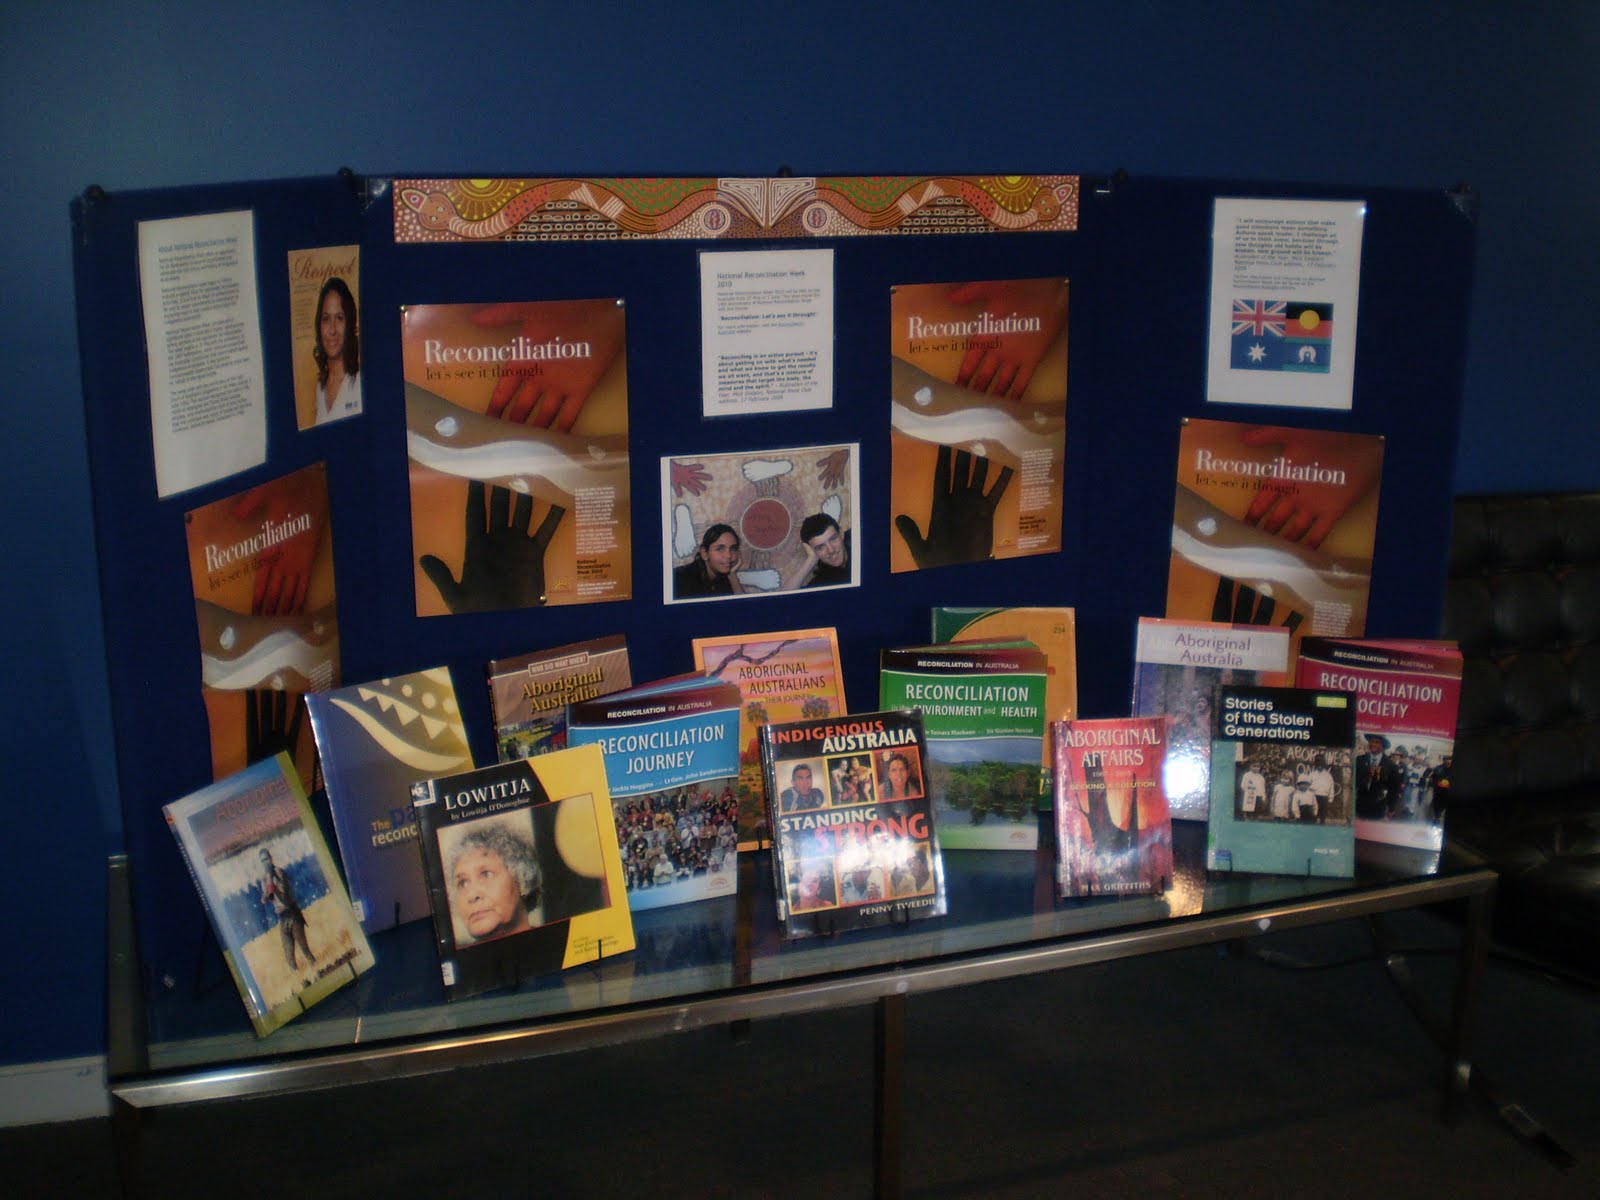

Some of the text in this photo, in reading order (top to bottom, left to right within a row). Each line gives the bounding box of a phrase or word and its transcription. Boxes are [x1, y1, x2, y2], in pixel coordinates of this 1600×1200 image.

[294, 256, 357, 284] Respect
[717, 271, 742, 279] National
[744, 271, 788, 279] Reconciliation
[908, 312, 1041, 339] Reconciliation
[424, 336, 591, 364] Reconciliation
[909, 336, 1002, 353] let's see it through
[426, 364, 544, 380] let's see it through
[1195, 449, 1346, 485] Reconciliation
[205, 513, 311, 573] Reconciliation
[1175, 633, 1251, 653] Aboriginal
[531, 664, 544, 673] WHO
[554, 659, 568, 668] WHAT
[917, 660, 973, 668] RECONCILIATION
[1180, 649, 1243, 666] Australia
[1334, 651, 1388, 664] RECONCILIATION
[1400, 660, 1434, 669] AUSTRALIA
[739, 662, 809, 680] ABORIGINAL
[522, 667, 604, 698] Aboriginal
[750, 676, 826, 694] AUSTRALIANS
[1320, 672, 1442, 703] RECONCILIATION
[531, 686, 599, 714] Australia
[906, 684, 1029, 702] RECONCILIATION
[607, 707, 666, 719] RECONCILIATION
[677, 701, 712, 711] AUSTRALIA
[983, 707, 996, 715] and
[1001, 707, 1037, 717] HEALTH
[1225, 697, 1273, 712] Stories
[1358, 698, 1408, 719] OCIETY
[1225, 712, 1314, 727] of the Stolen
[598, 724, 724, 755] RECONCILIATION
[772, 720, 884, 744] INDIGENOUS
[822, 728, 917, 753] AUSTRALIA
[1065, 728, 1161, 748] ABORIGINAL
[1225, 725, 1310, 740] Generations
[626, 750, 694, 774] JOURNEY
[1081, 749, 1144, 768] AFFAIRS
[444, 778, 531, 810] LOWITJA
[461, 807, 487, 818] Lowitja
[781, 808, 878, 832] STANDING
[371, 820, 390, 832] The
[814, 813, 929, 853] STRONG
[860, 905, 893, 916] PENNY
